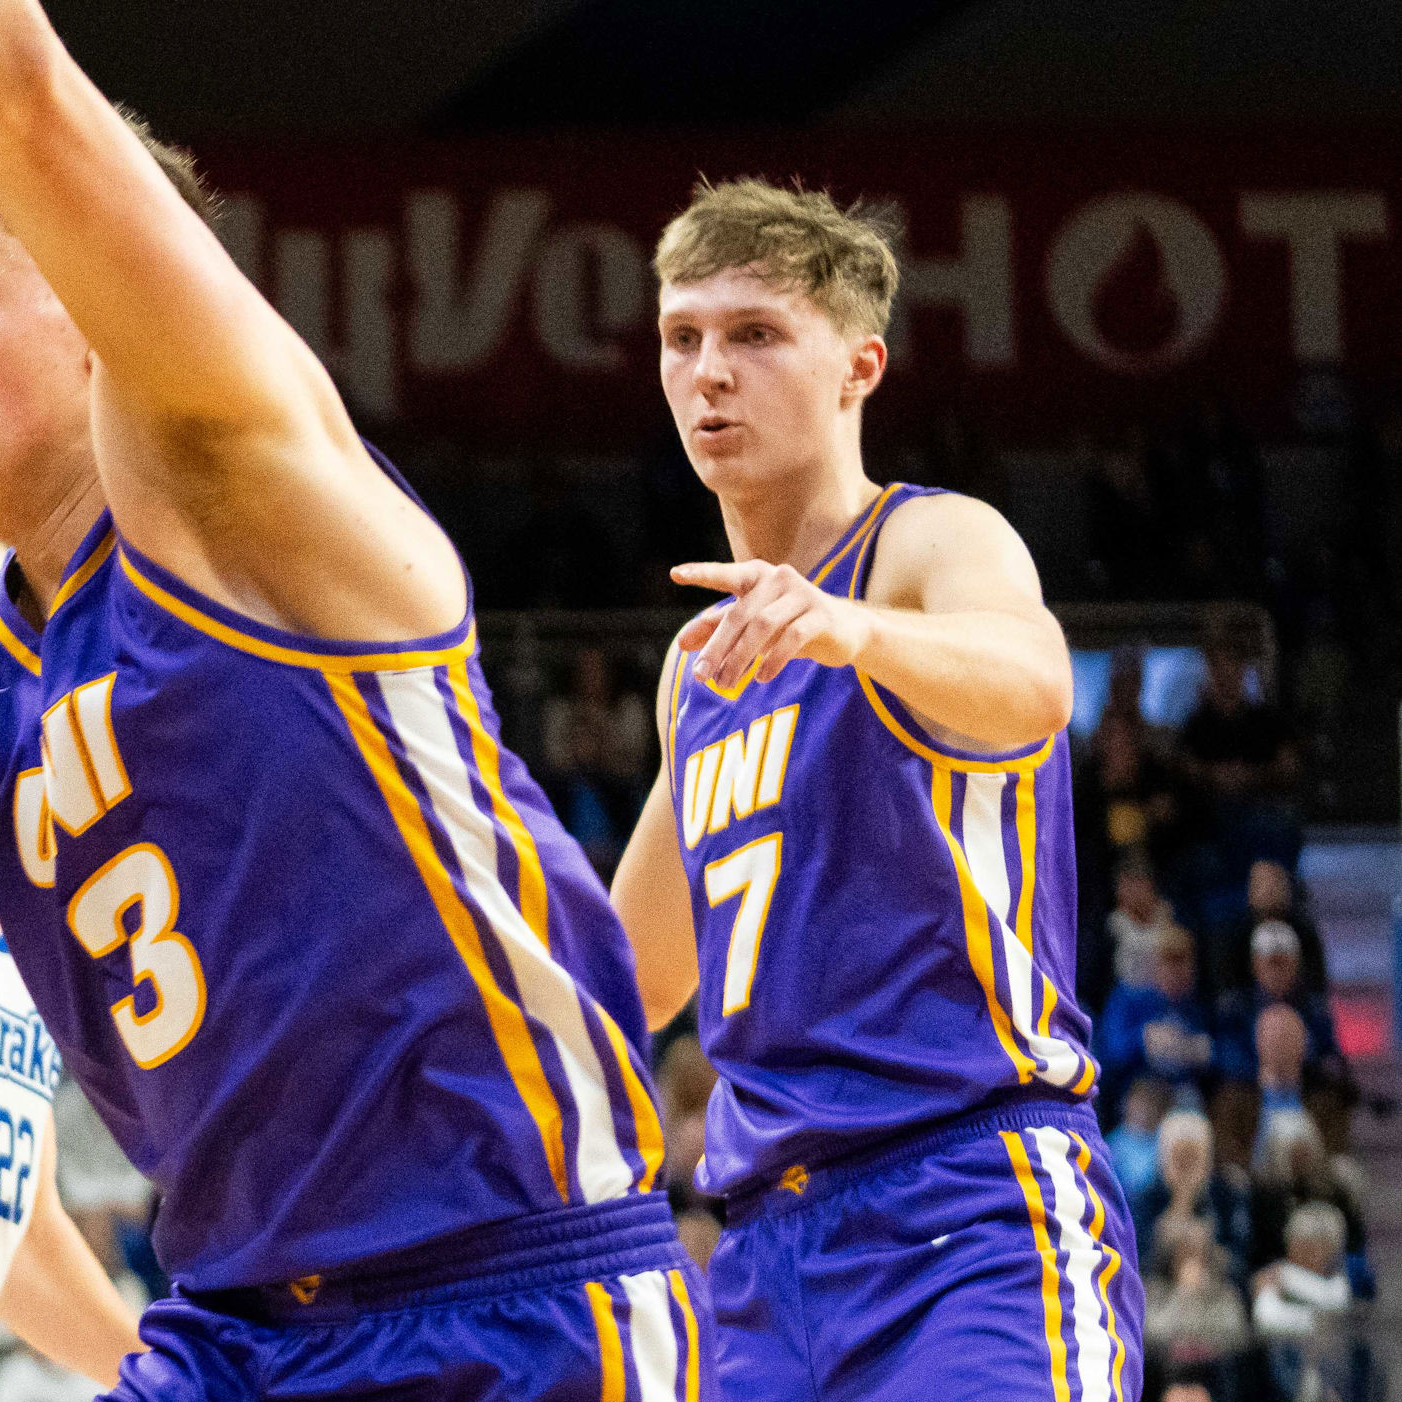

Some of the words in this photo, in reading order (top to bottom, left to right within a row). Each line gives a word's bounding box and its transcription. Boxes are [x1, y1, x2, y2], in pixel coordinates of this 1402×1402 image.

[681, 702, 801, 852] UNI
[66, 841, 208, 1072] 3
[704, 830, 784, 1018] 7
